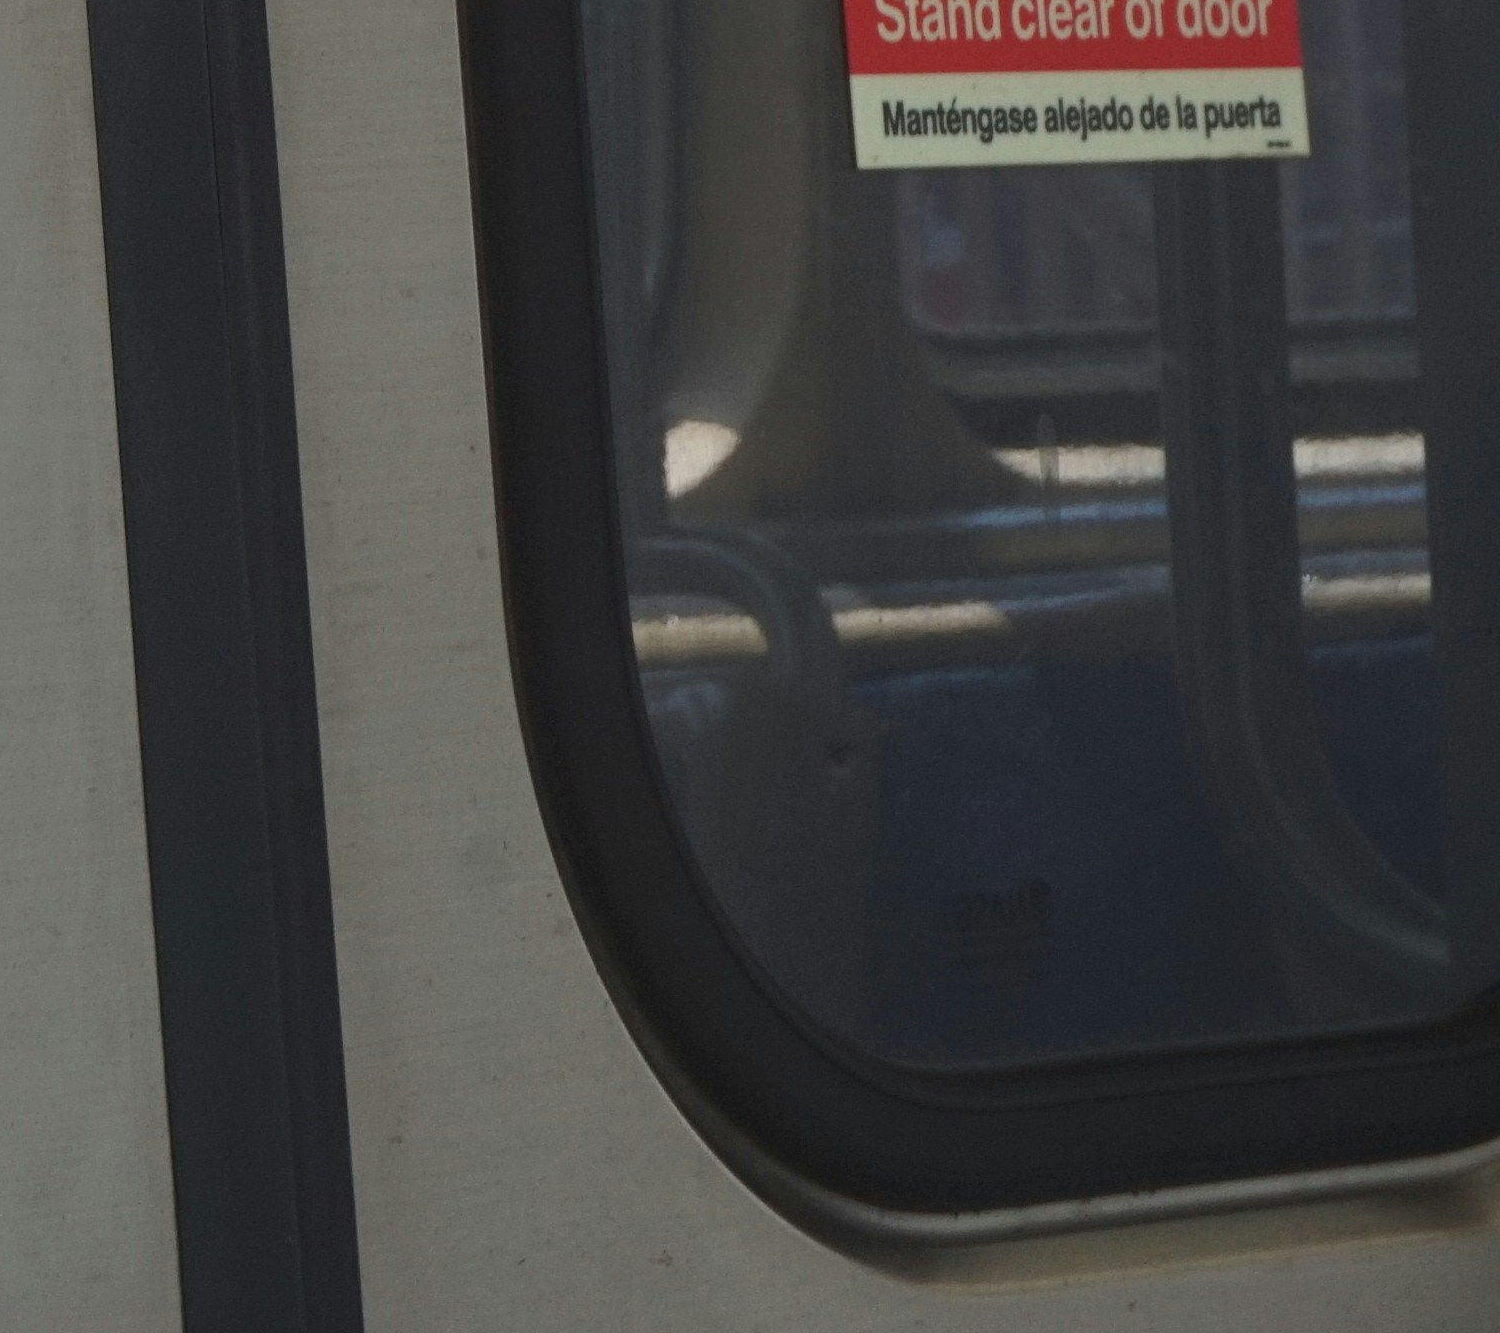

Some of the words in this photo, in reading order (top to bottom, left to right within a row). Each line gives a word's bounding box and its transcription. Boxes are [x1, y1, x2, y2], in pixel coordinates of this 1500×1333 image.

[882, 97, 1038, 143] Manténgase
[1043, 96, 1134, 140] alejado
[1140, 95, 1171, 130] de
[1177, 94, 1198, 129] la
[1204, 94, 1282, 138] puerta
